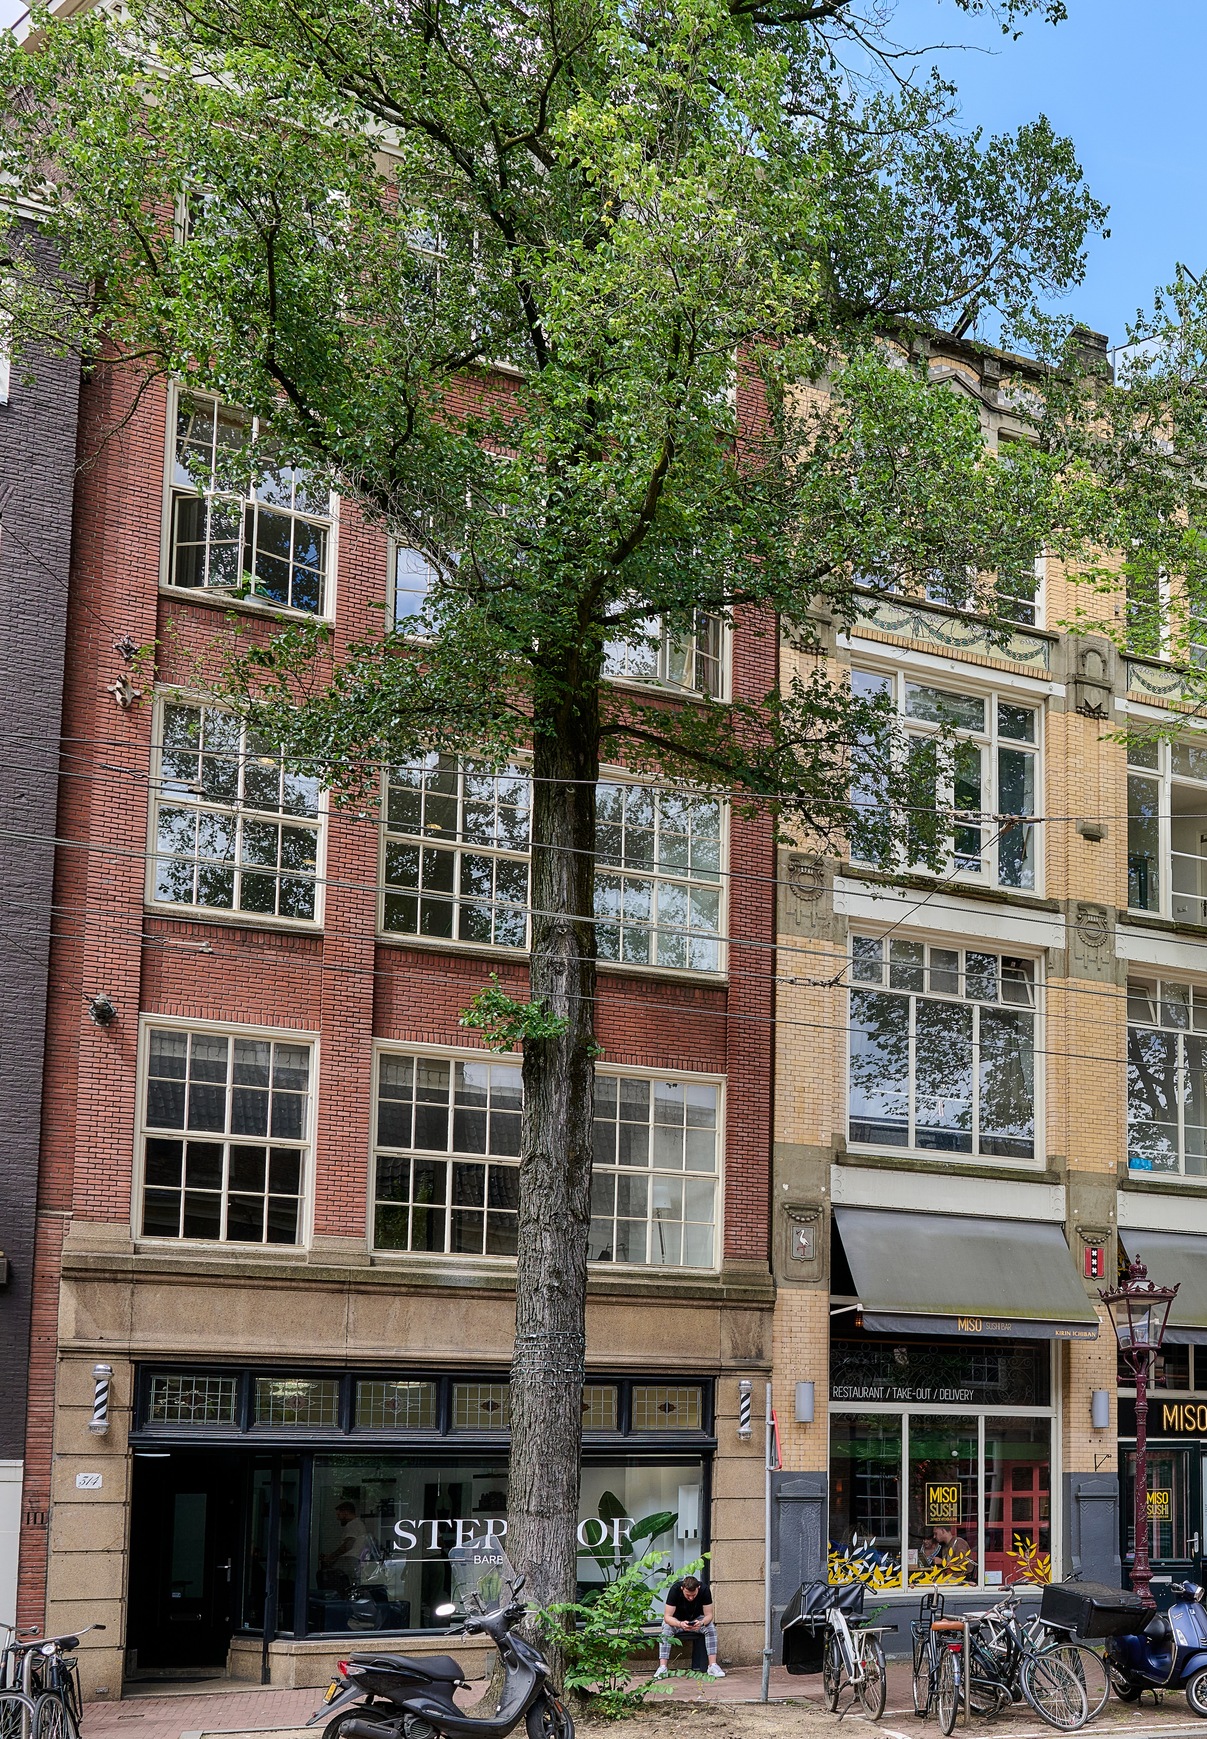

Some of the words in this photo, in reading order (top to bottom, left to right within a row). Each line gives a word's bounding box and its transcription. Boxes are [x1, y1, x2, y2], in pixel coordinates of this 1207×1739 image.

[957, 1317, 983, 1332] MISO
[985, 1322, 1001, 1331] SUSHI
[1001, 1323, 1012, 1331] BAR
[833, 1386, 884, 1399] RESTAURANT
[893, 1387, 932, 1400] TAKE-OUT
[940, 1388, 974, 1401] DELIVERY
[929, 1487, 958, 1503] MISO
[1146, 1491, 1169, 1505] MISO
[929, 1503, 958, 1517] SUSHI
[1146, 1504, 1169, 1515] SUSHI
